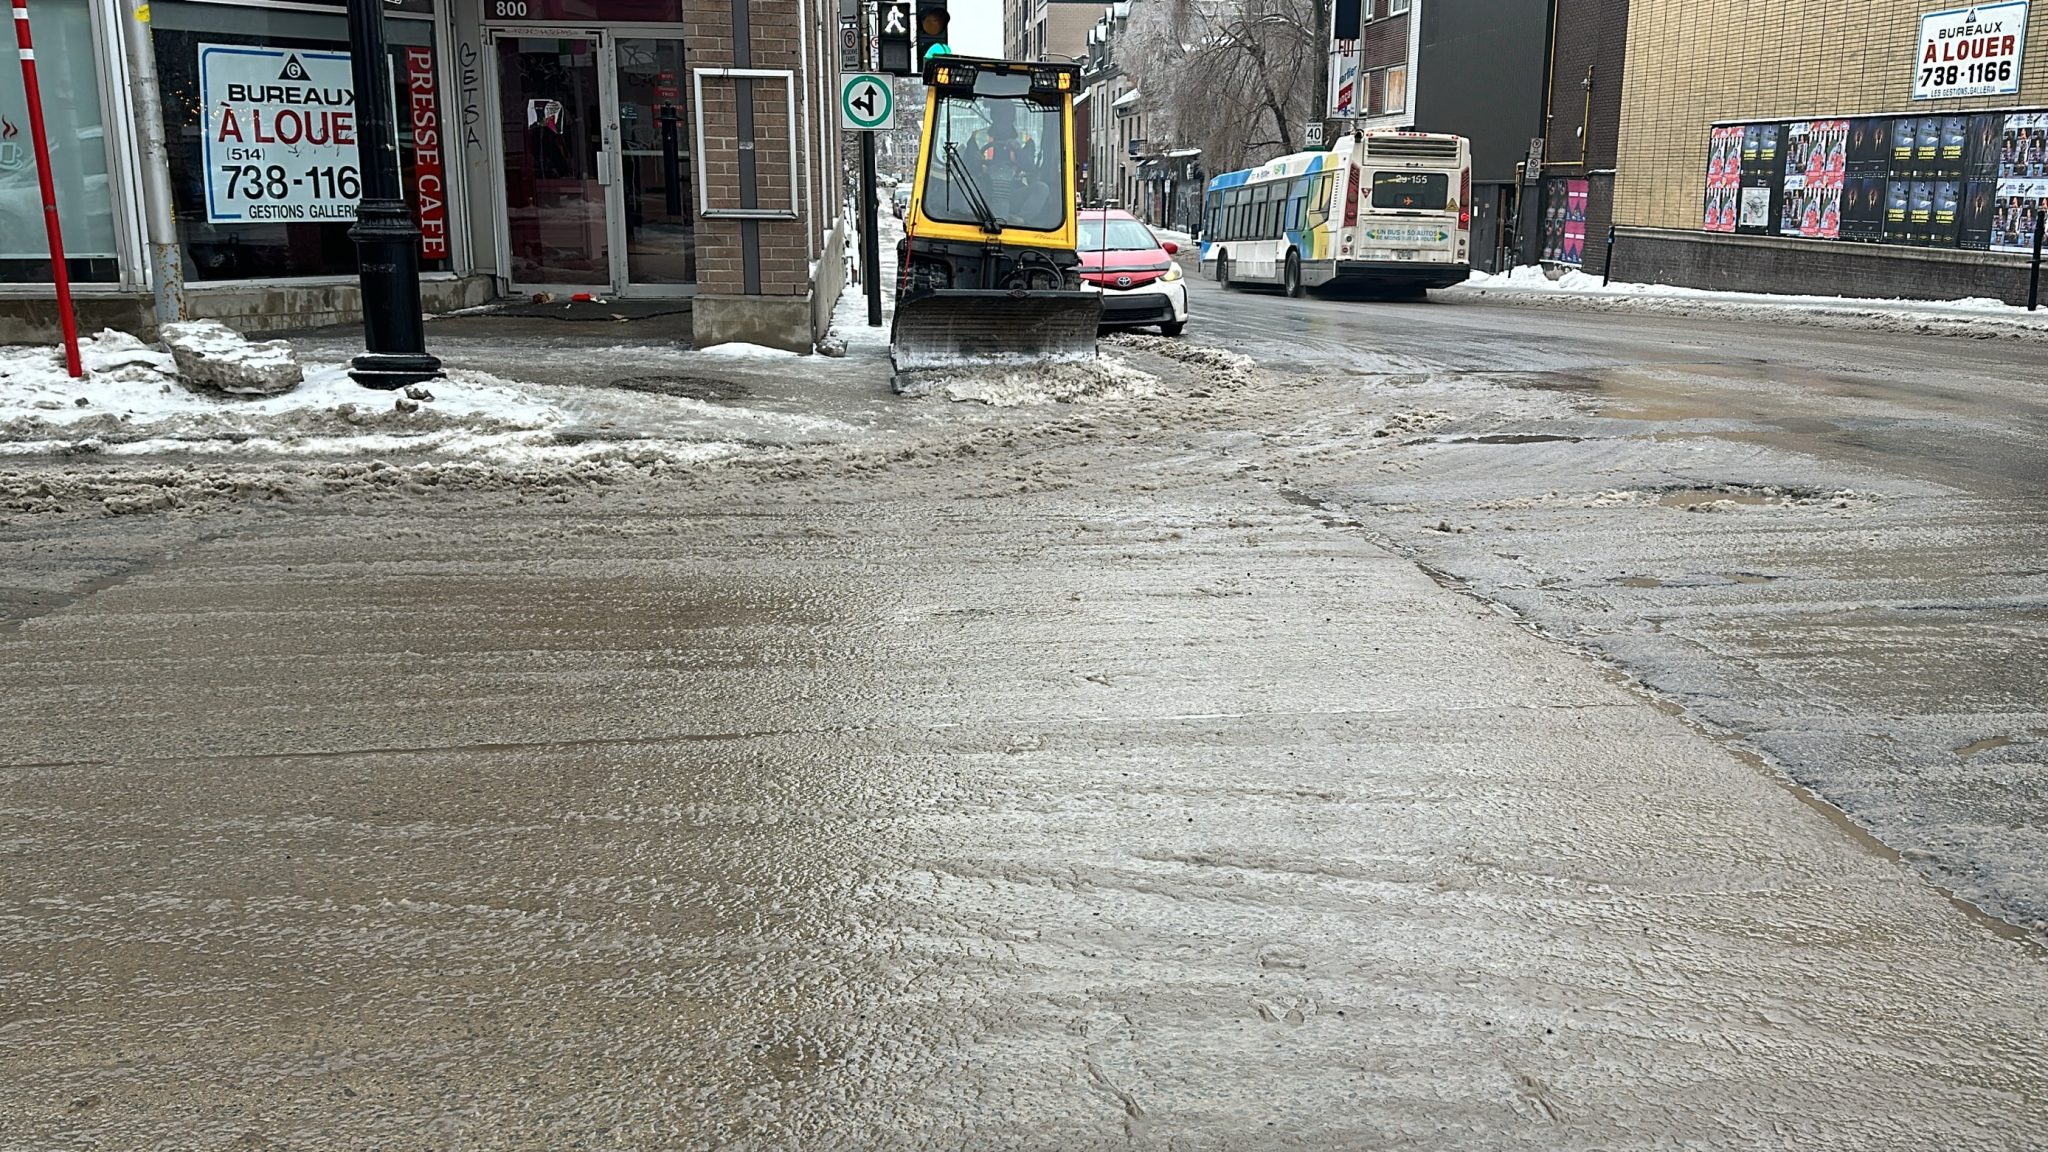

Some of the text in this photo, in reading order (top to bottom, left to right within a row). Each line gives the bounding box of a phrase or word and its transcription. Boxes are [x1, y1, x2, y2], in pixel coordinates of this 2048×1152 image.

[496, 1, 527, 17] 800
[1938, 21, 2003, 39] BUREAUX
[1923, 35, 2015, 64] À LOUER
[218, 101, 356, 145] À LOUE
[1306, 128, 1321, 140] 40
[226, 147, 265, 161] (514)
[408, 50, 445, 253] PRESSE CAFE
[221, 165, 361, 200] 738-116
[249, 204, 357, 219] GESTIONS GALLERI
